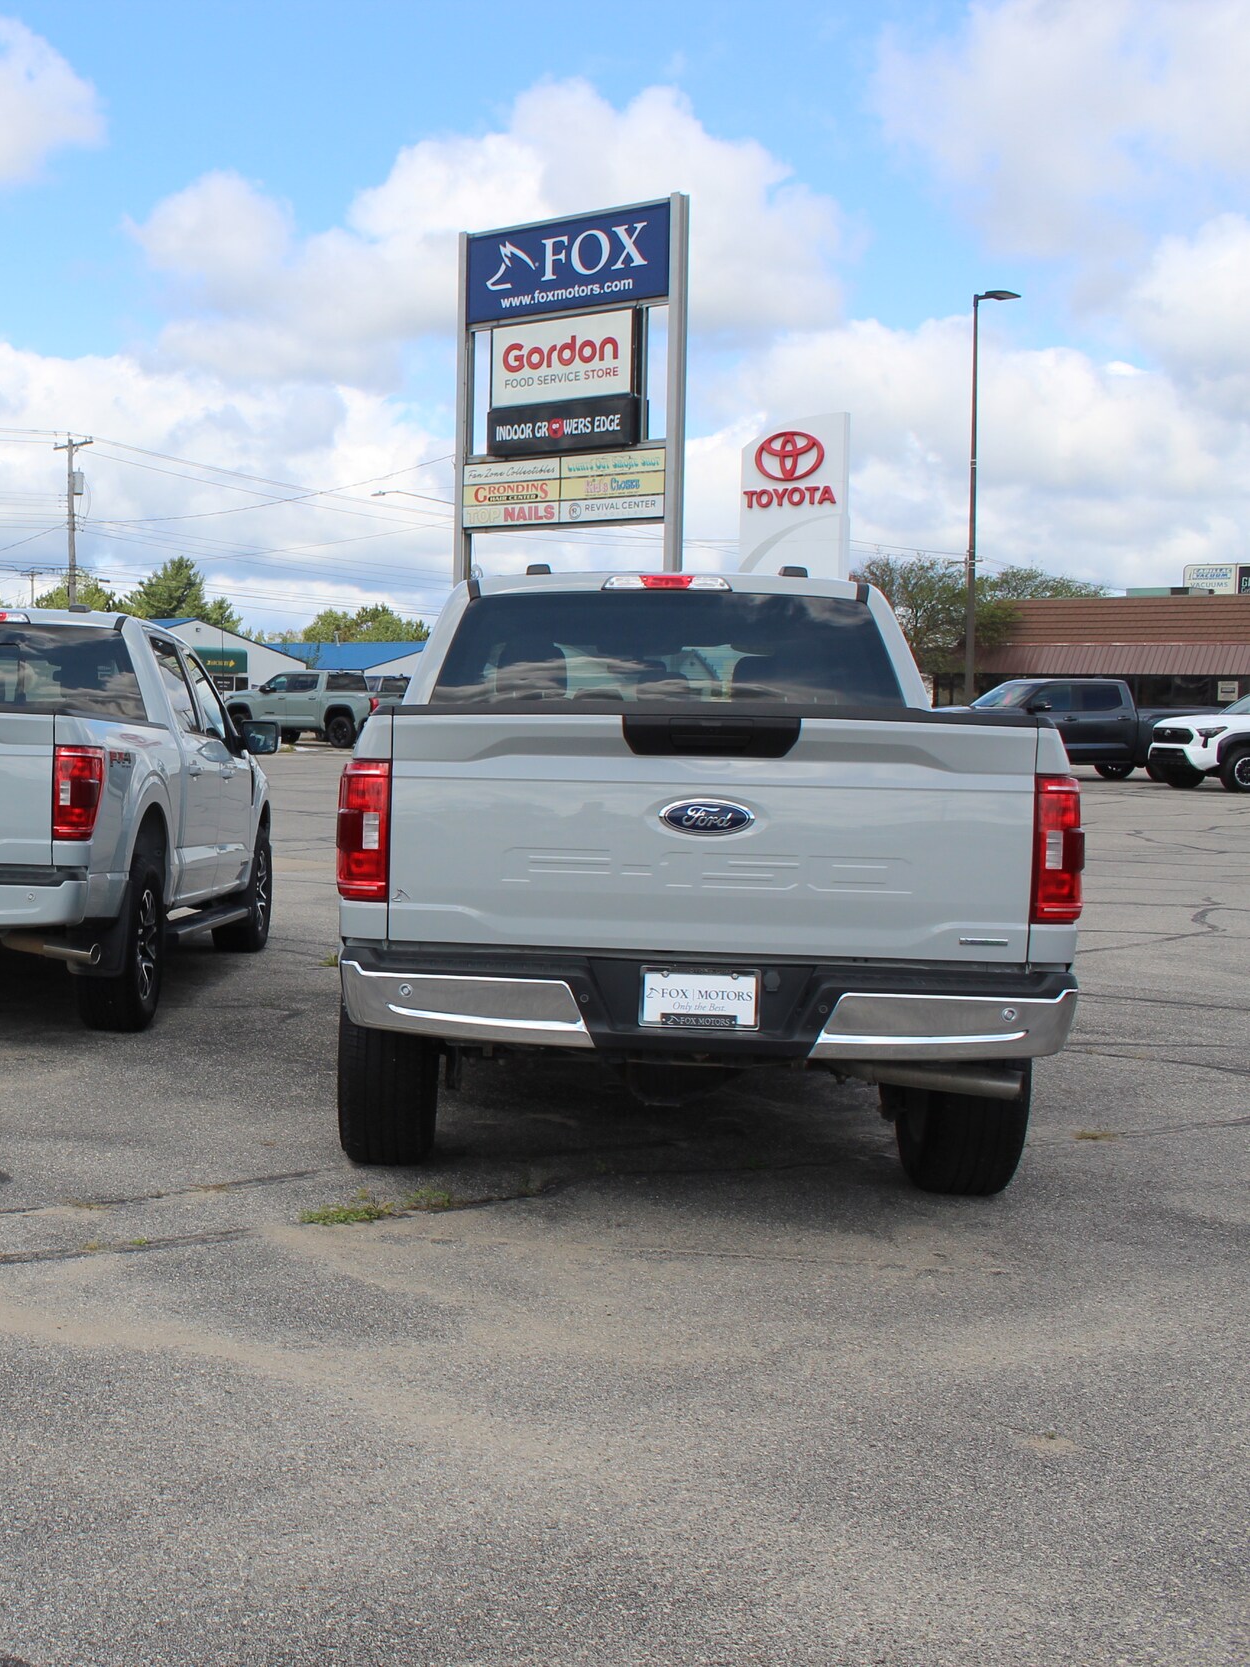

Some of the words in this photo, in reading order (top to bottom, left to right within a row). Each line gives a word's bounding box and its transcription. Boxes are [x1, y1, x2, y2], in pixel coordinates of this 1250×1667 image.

[540, 221, 648, 282] FOX
[501, 278, 633, 309] www.foxmotors.com
[503, 335, 619, 373] Gordon
[504, 377, 534, 389] FOOD
[537, 371, 581, 386] SERVICE
[583, 366, 619, 380] STORE
[496, 421, 533, 441] INDOOR
[594, 414, 621, 432] EDGE
[468, 469, 483, 479] Fan
[484, 468, 505, 478] Zone
[506, 464, 557, 478] Collectibles
[474, 482, 549, 503] GRONDINS
[509, 493, 537, 501] CENTER
[743, 485, 837, 509] TOYOTA
[467, 507, 501, 524] TOP
[503, 504, 556, 522] NAILS
[584, 502, 620, 512] REVIVAL
[621, 500, 656, 510] CENTER
[681, 805, 734, 829] Ford
[661, 988, 689, 999] FOX
[697, 990, 753, 1002] MOTORS
[672, 1001, 693, 1012] Only
[693, 1002, 707, 1011] the
[680, 1017, 696, 1025] FOX
[697, 1018, 731, 1026] MOTORS
